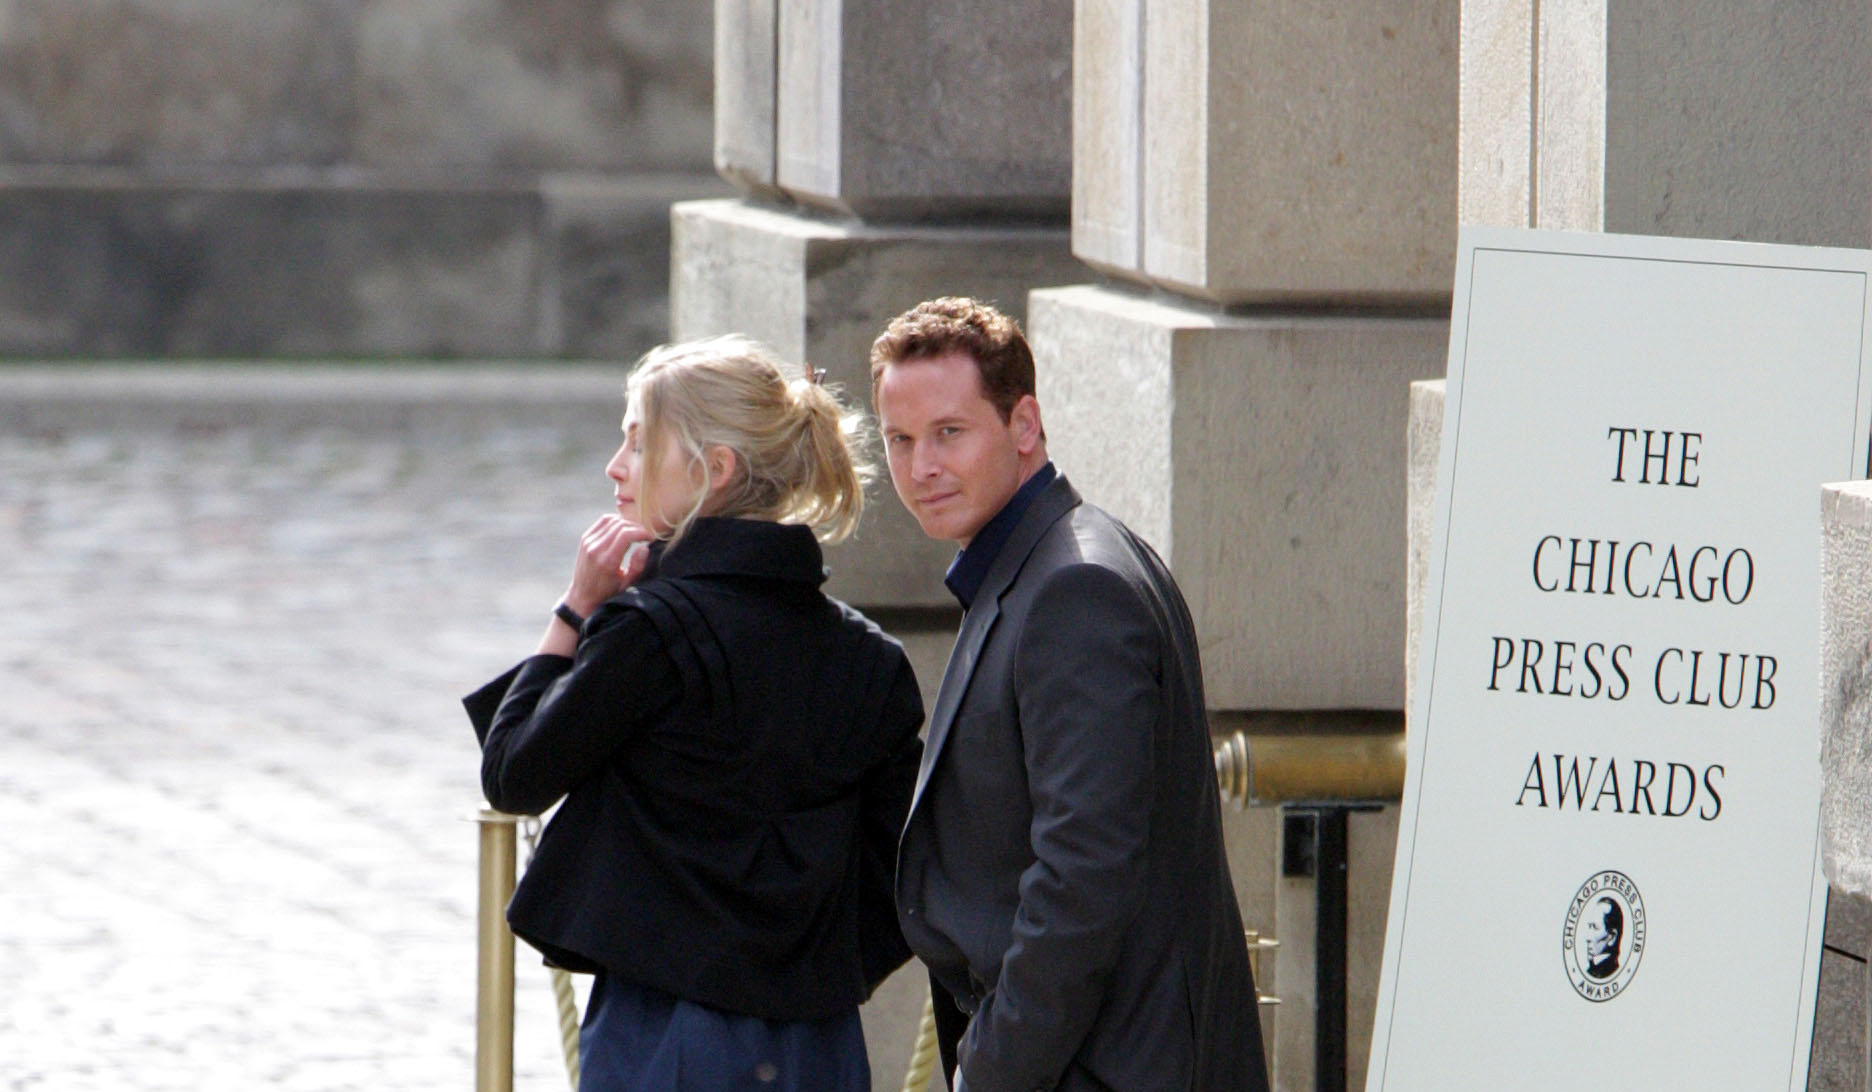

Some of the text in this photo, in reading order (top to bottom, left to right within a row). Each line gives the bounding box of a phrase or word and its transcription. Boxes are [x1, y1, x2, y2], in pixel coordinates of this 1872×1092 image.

[1608, 427, 1701, 487] THE
[1533, 536, 1753, 605] CHICAGO
[1487, 637, 1777, 709] PRESS CLUB
[1516, 752, 1724, 821] AWARDS
[1564, 874, 1644, 953] CHICAGO PRESS CLUB
[1578, 980, 1620, 998] AWARD
